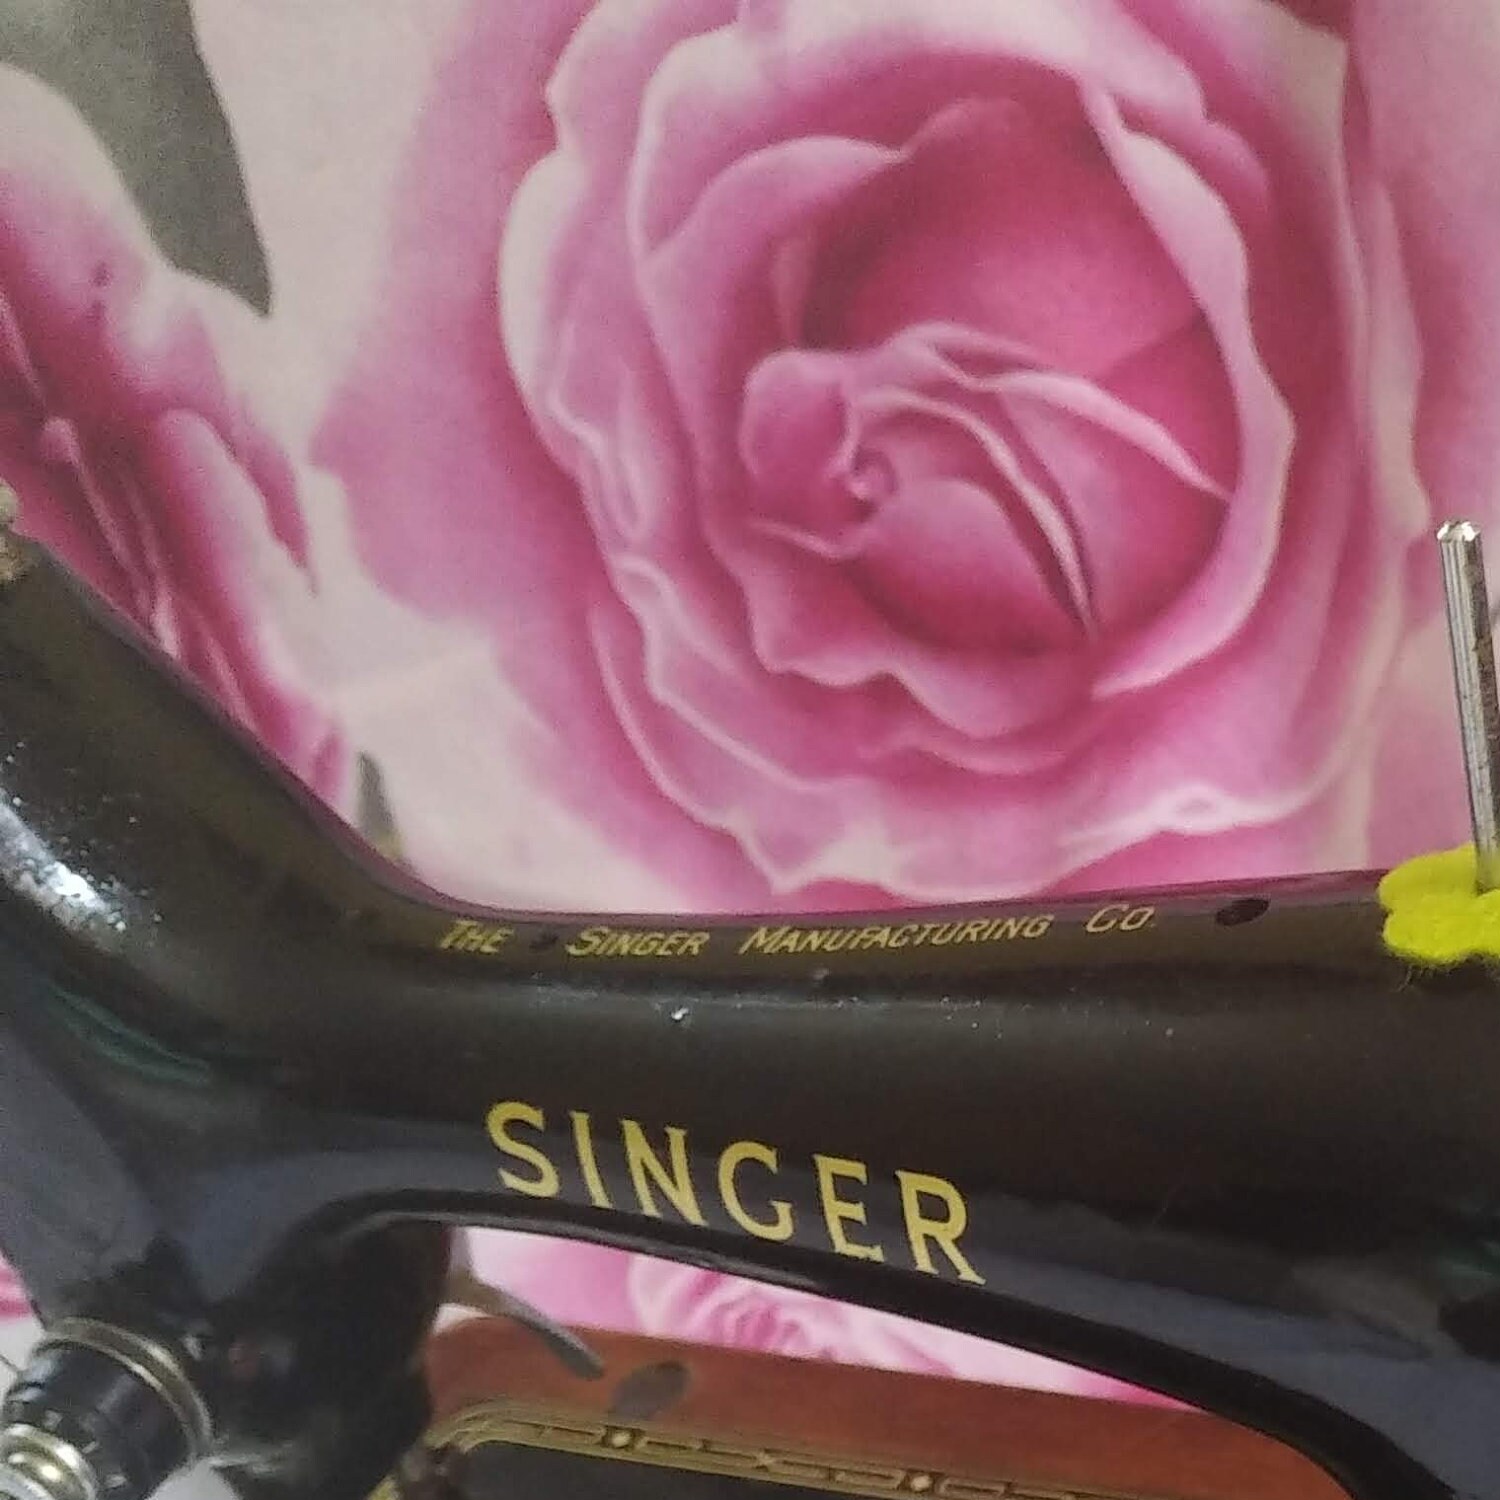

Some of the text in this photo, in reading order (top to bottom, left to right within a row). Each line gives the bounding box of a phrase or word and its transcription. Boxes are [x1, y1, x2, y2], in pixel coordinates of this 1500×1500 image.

[441, 919, 514, 954] THE
[566, 923, 710, 957] SINGER
[738, 914, 1054, 956] MANUFACTURING
[484, 1101, 987, 1285] SINGER
